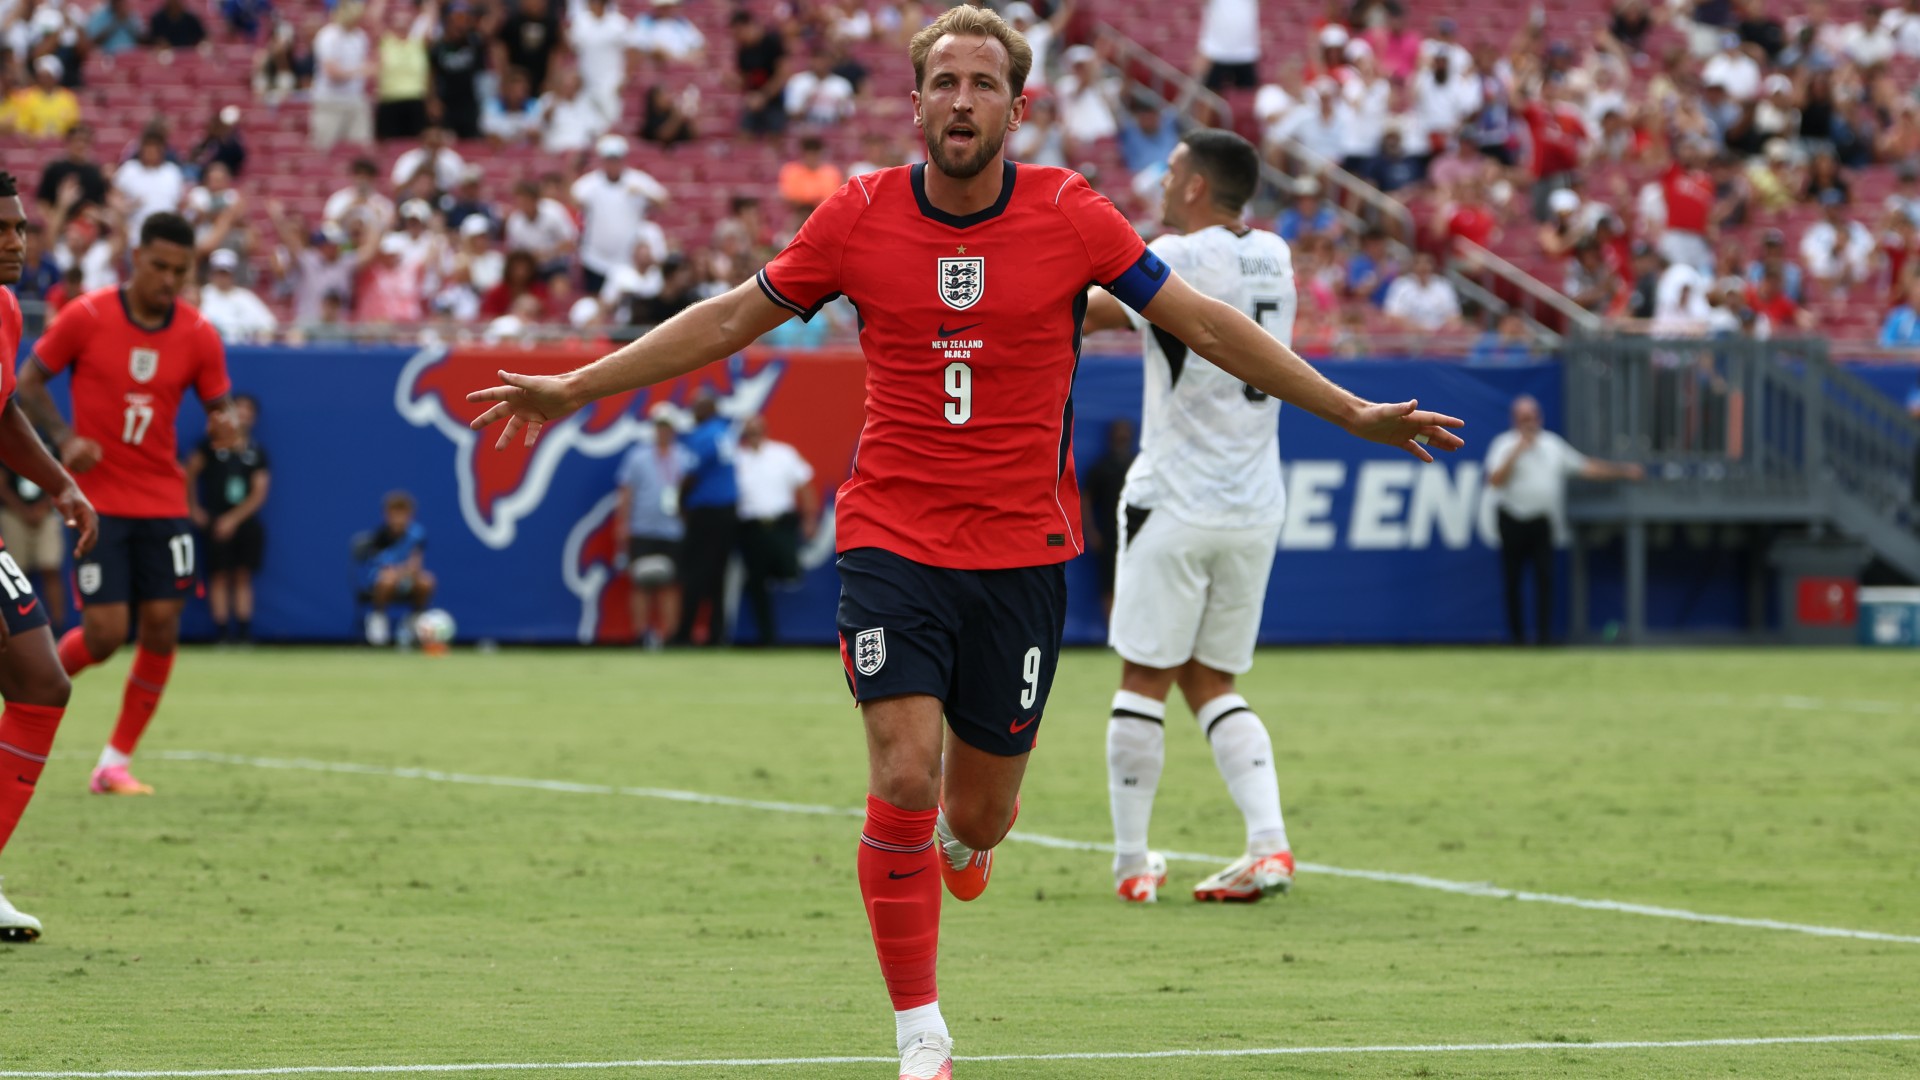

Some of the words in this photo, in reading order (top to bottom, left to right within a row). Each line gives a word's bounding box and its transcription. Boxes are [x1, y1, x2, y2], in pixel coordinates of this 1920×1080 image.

[1138, 250, 1166, 282] C
[931, 340, 948, 349] NEW
[949, 340, 983, 349] ZEALAND
[944, 362, 972, 425] 9
[123, 406, 153, 446] 17
[0, 550, 33, 600] 19
[1019, 645, 1042, 710] 9
